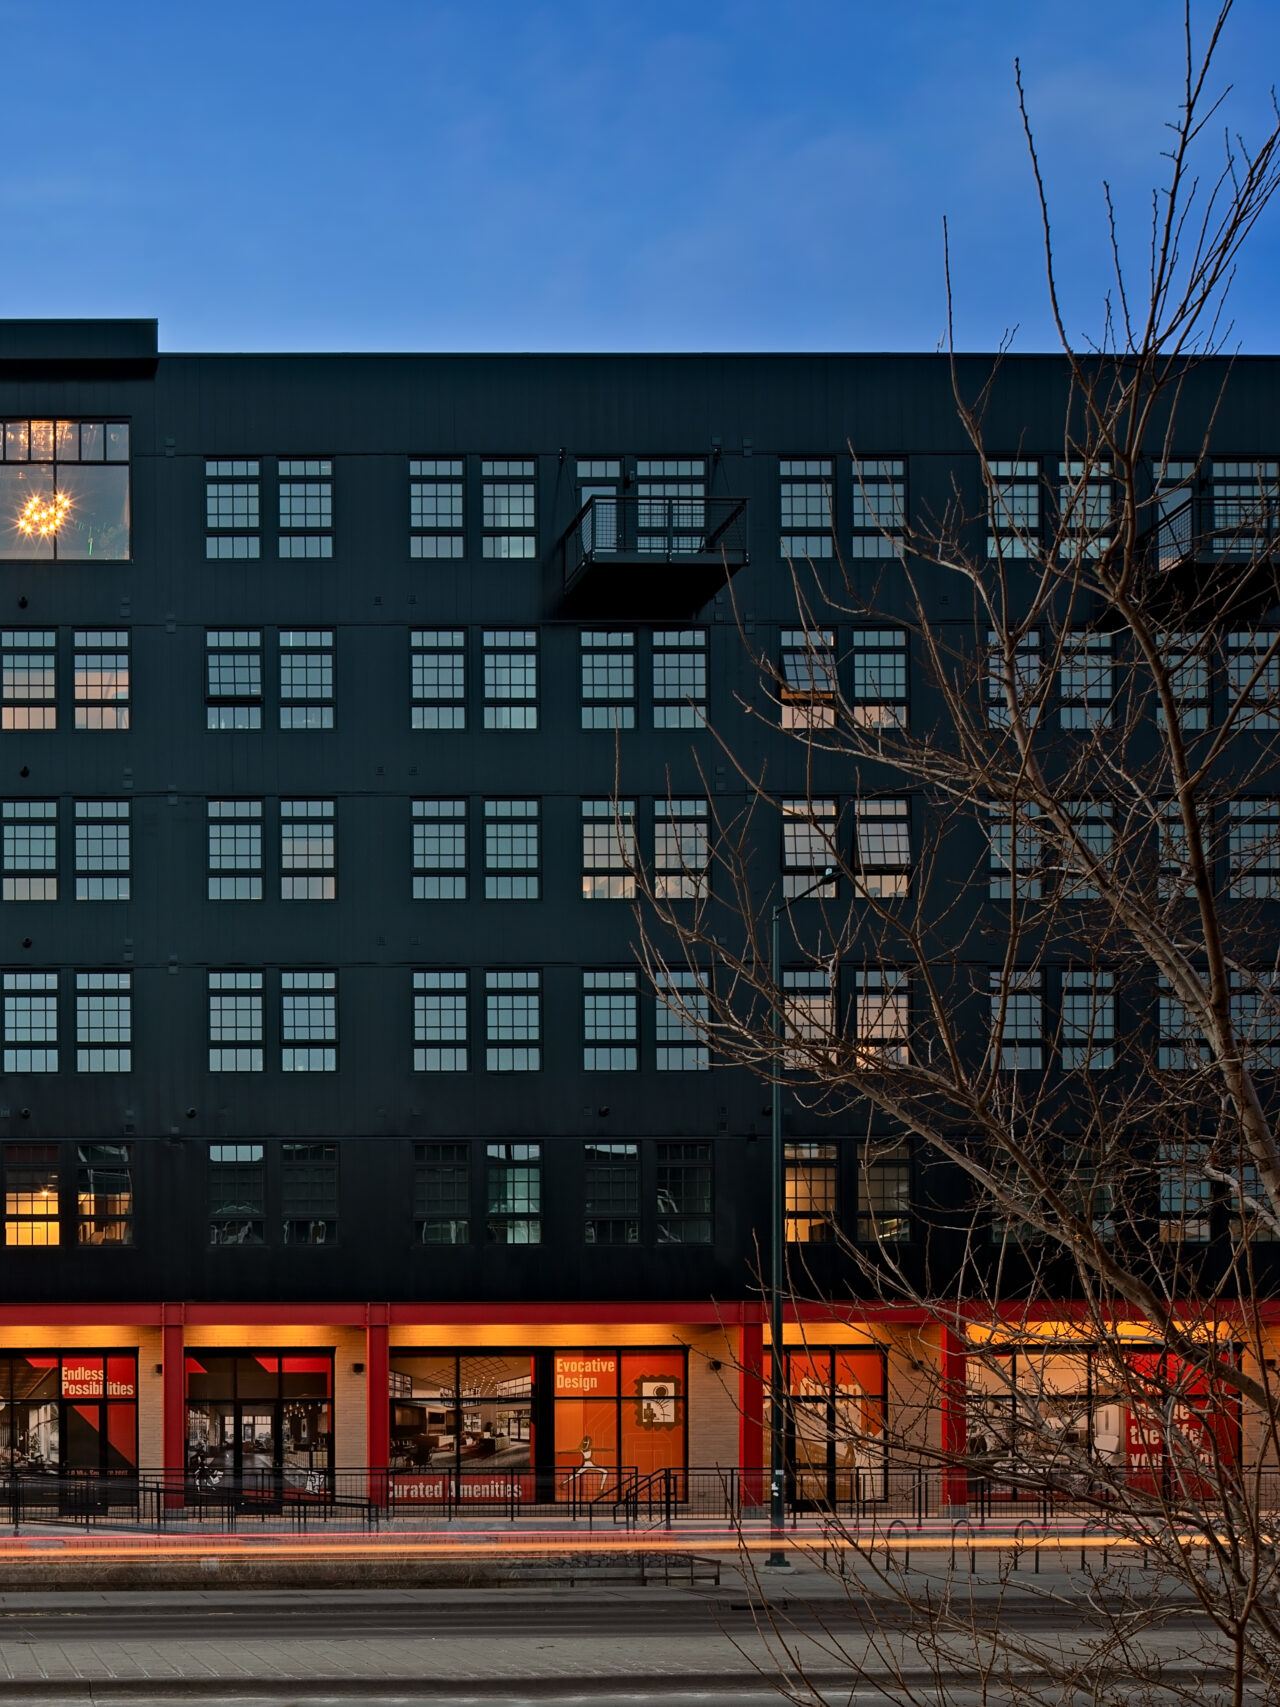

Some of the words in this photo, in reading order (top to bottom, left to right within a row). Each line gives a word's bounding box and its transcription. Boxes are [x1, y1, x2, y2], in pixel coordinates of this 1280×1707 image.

[556, 1358, 615, 1373] Evocative
[61, 1366, 105, 1381] Endless
[61, 1381, 134, 1396] Possibilities
[556, 1374, 598, 1392] Design
